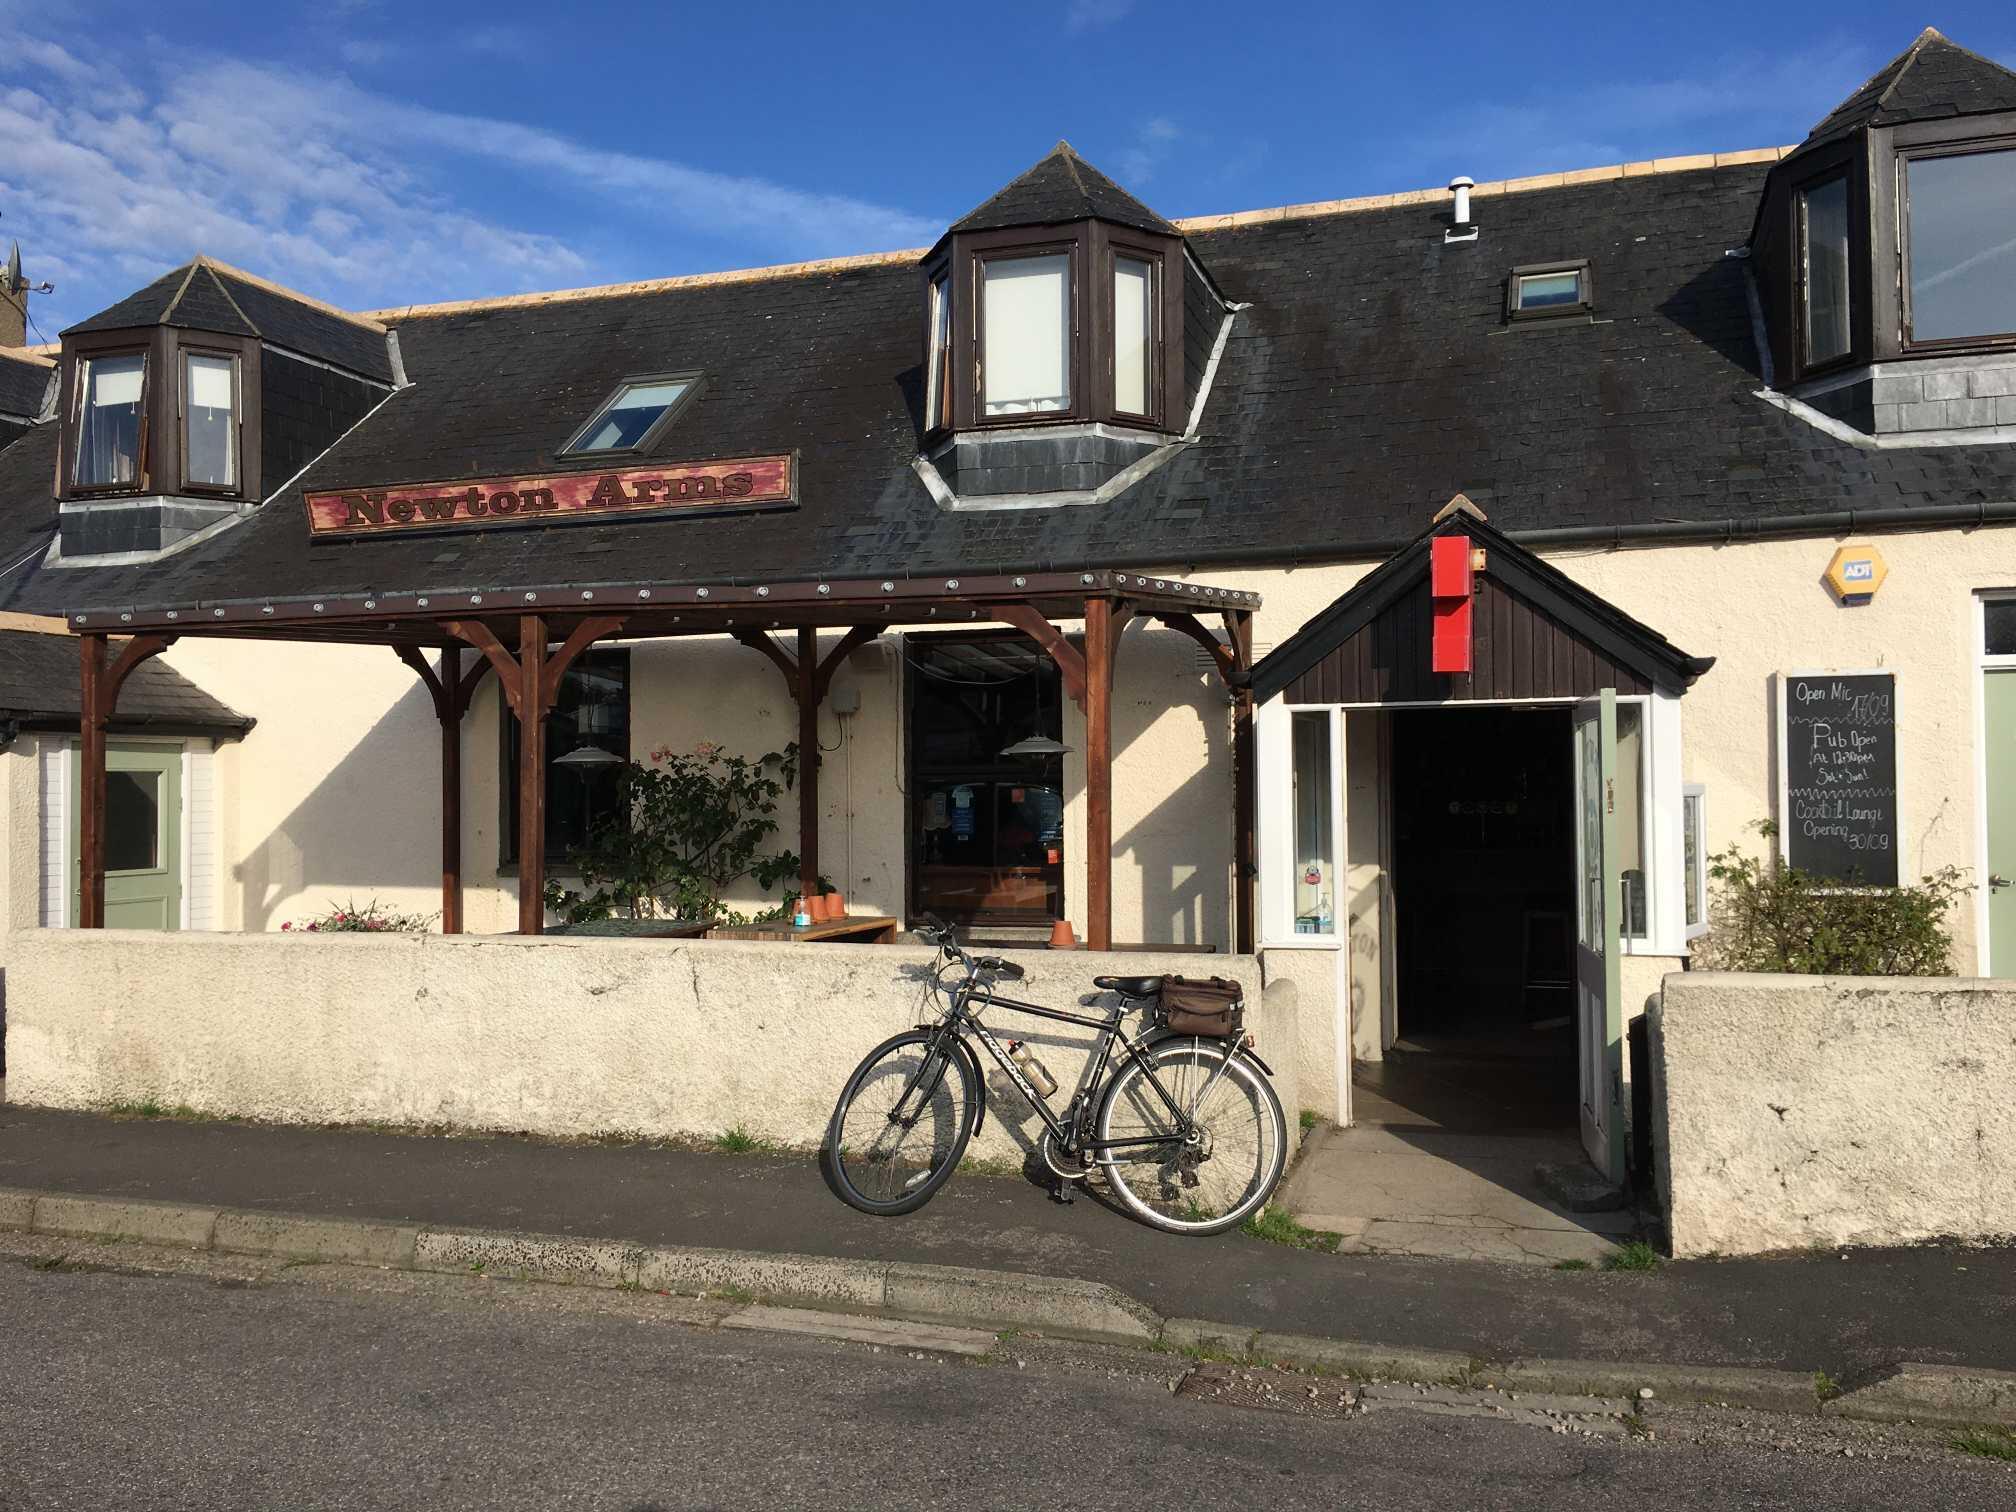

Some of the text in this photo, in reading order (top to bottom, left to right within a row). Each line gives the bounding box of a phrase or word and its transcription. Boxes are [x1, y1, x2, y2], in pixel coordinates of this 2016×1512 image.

[340, 472, 754, 526] Newton Arms
[1845, 564, 1871, 578] ADT
[1796, 682, 1826, 706] Open
[1831, 681, 1853, 701] Mic
[1812, 723, 1878, 753] Pub Open
[1812, 752, 1829, 764] At
[1816, 767, 1839, 786] Sat
[1803, 820, 1889, 850] Opening 30/09
[980, 1030, 1037, 1100] ridgeback
